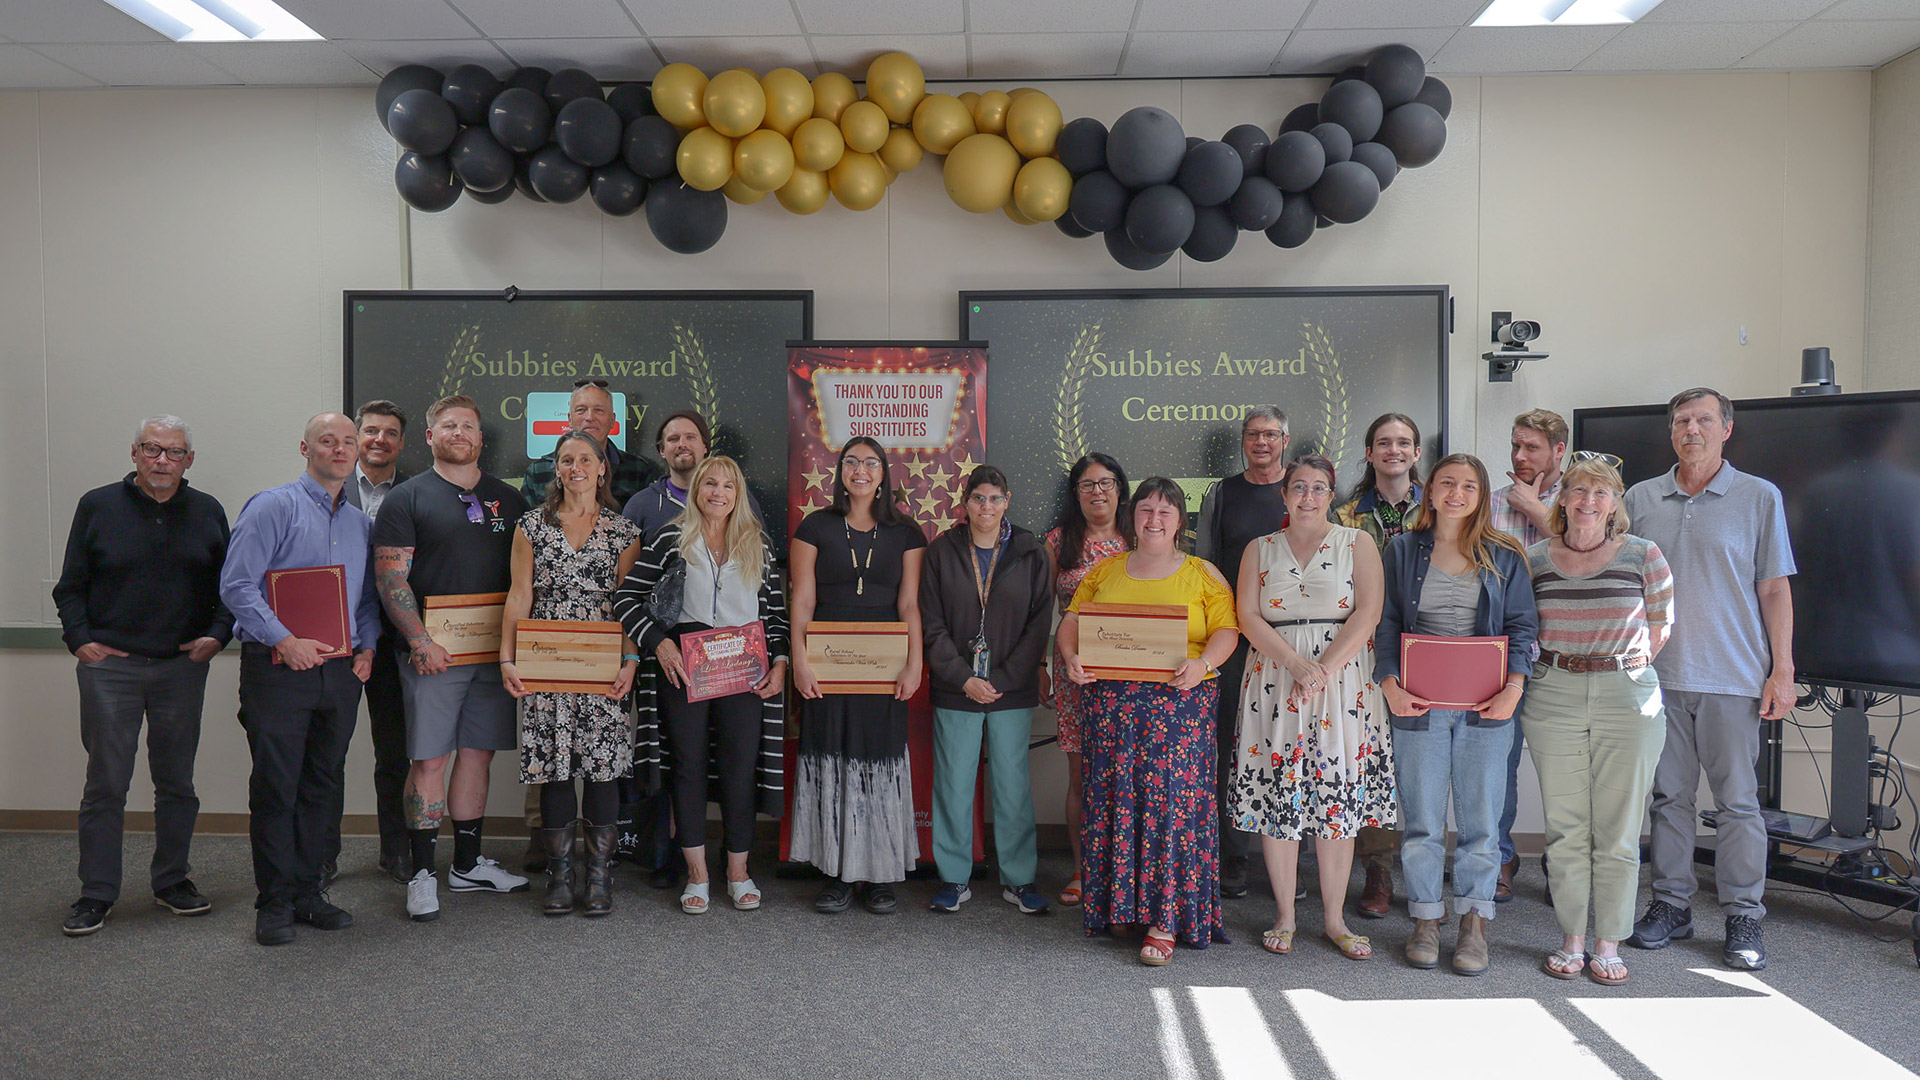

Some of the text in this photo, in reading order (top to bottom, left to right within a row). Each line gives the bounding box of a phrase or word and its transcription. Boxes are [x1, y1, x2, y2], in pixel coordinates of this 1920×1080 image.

[470, 350, 679, 378] Subbies Award
[1091, 347, 1308, 378] Subbies Award
[834, 383, 943, 399] THANK YOU TO OUR
[848, 402, 929, 418] OUTSTANDING
[1121, 396, 1256, 422] Ceremon
[849, 421, 927, 437] SUBSTITUTES
[491, 520, 506, 533] 24
[707, 640, 736, 652] CERTIFICATE
